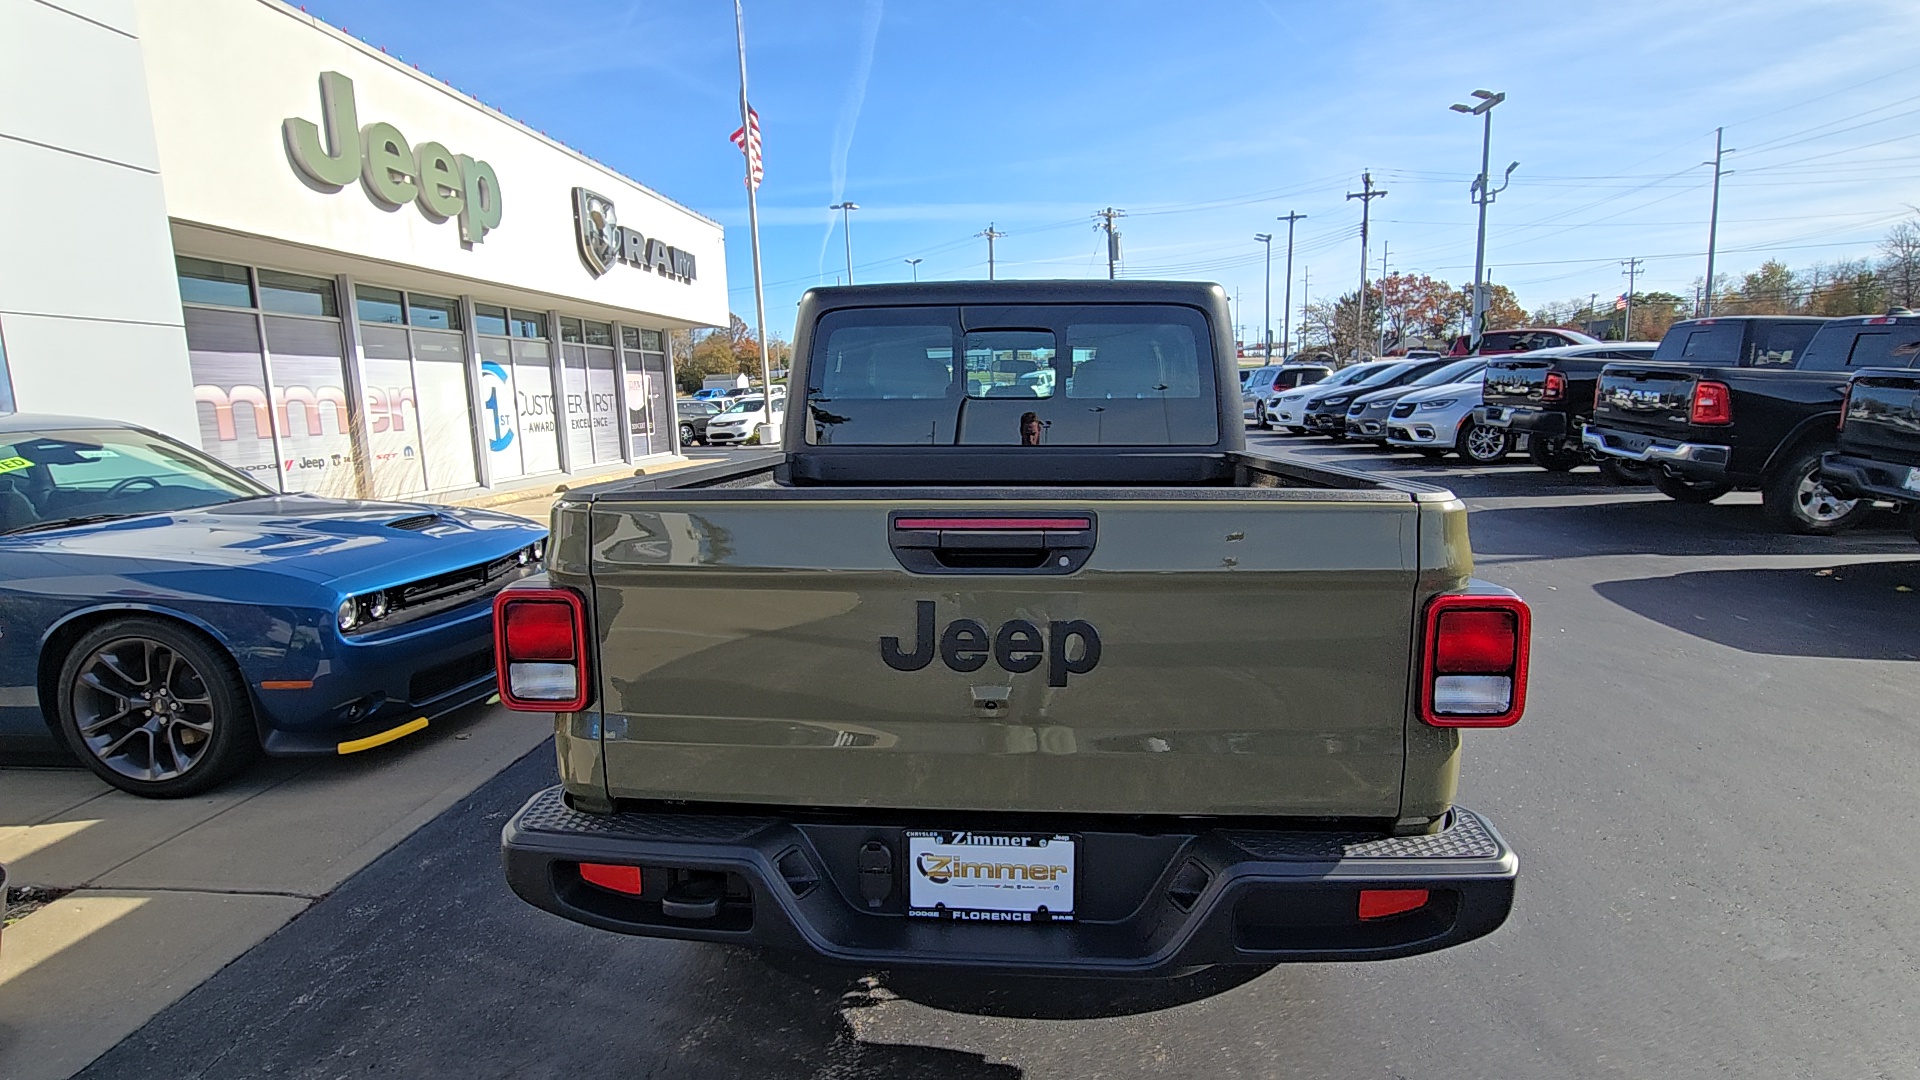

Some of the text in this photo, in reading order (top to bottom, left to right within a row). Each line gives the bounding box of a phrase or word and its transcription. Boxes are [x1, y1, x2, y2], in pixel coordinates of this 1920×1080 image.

[282, 71, 502, 245] Jeep
[618, 226, 697, 281] RAM
[514, 391, 583, 416] CUSTOER
[1615, 389, 1660, 403] RAM
[529, 417, 608, 433] AWARD EXCELENCE
[299, 456, 324, 469] Jeep
[880, 600, 1101, 687] Jeep
[952, 832, 1031, 847] Zimmer
[926, 855, 1068, 881] Zimmer
[953, 911, 1031, 921] FLORENCE
